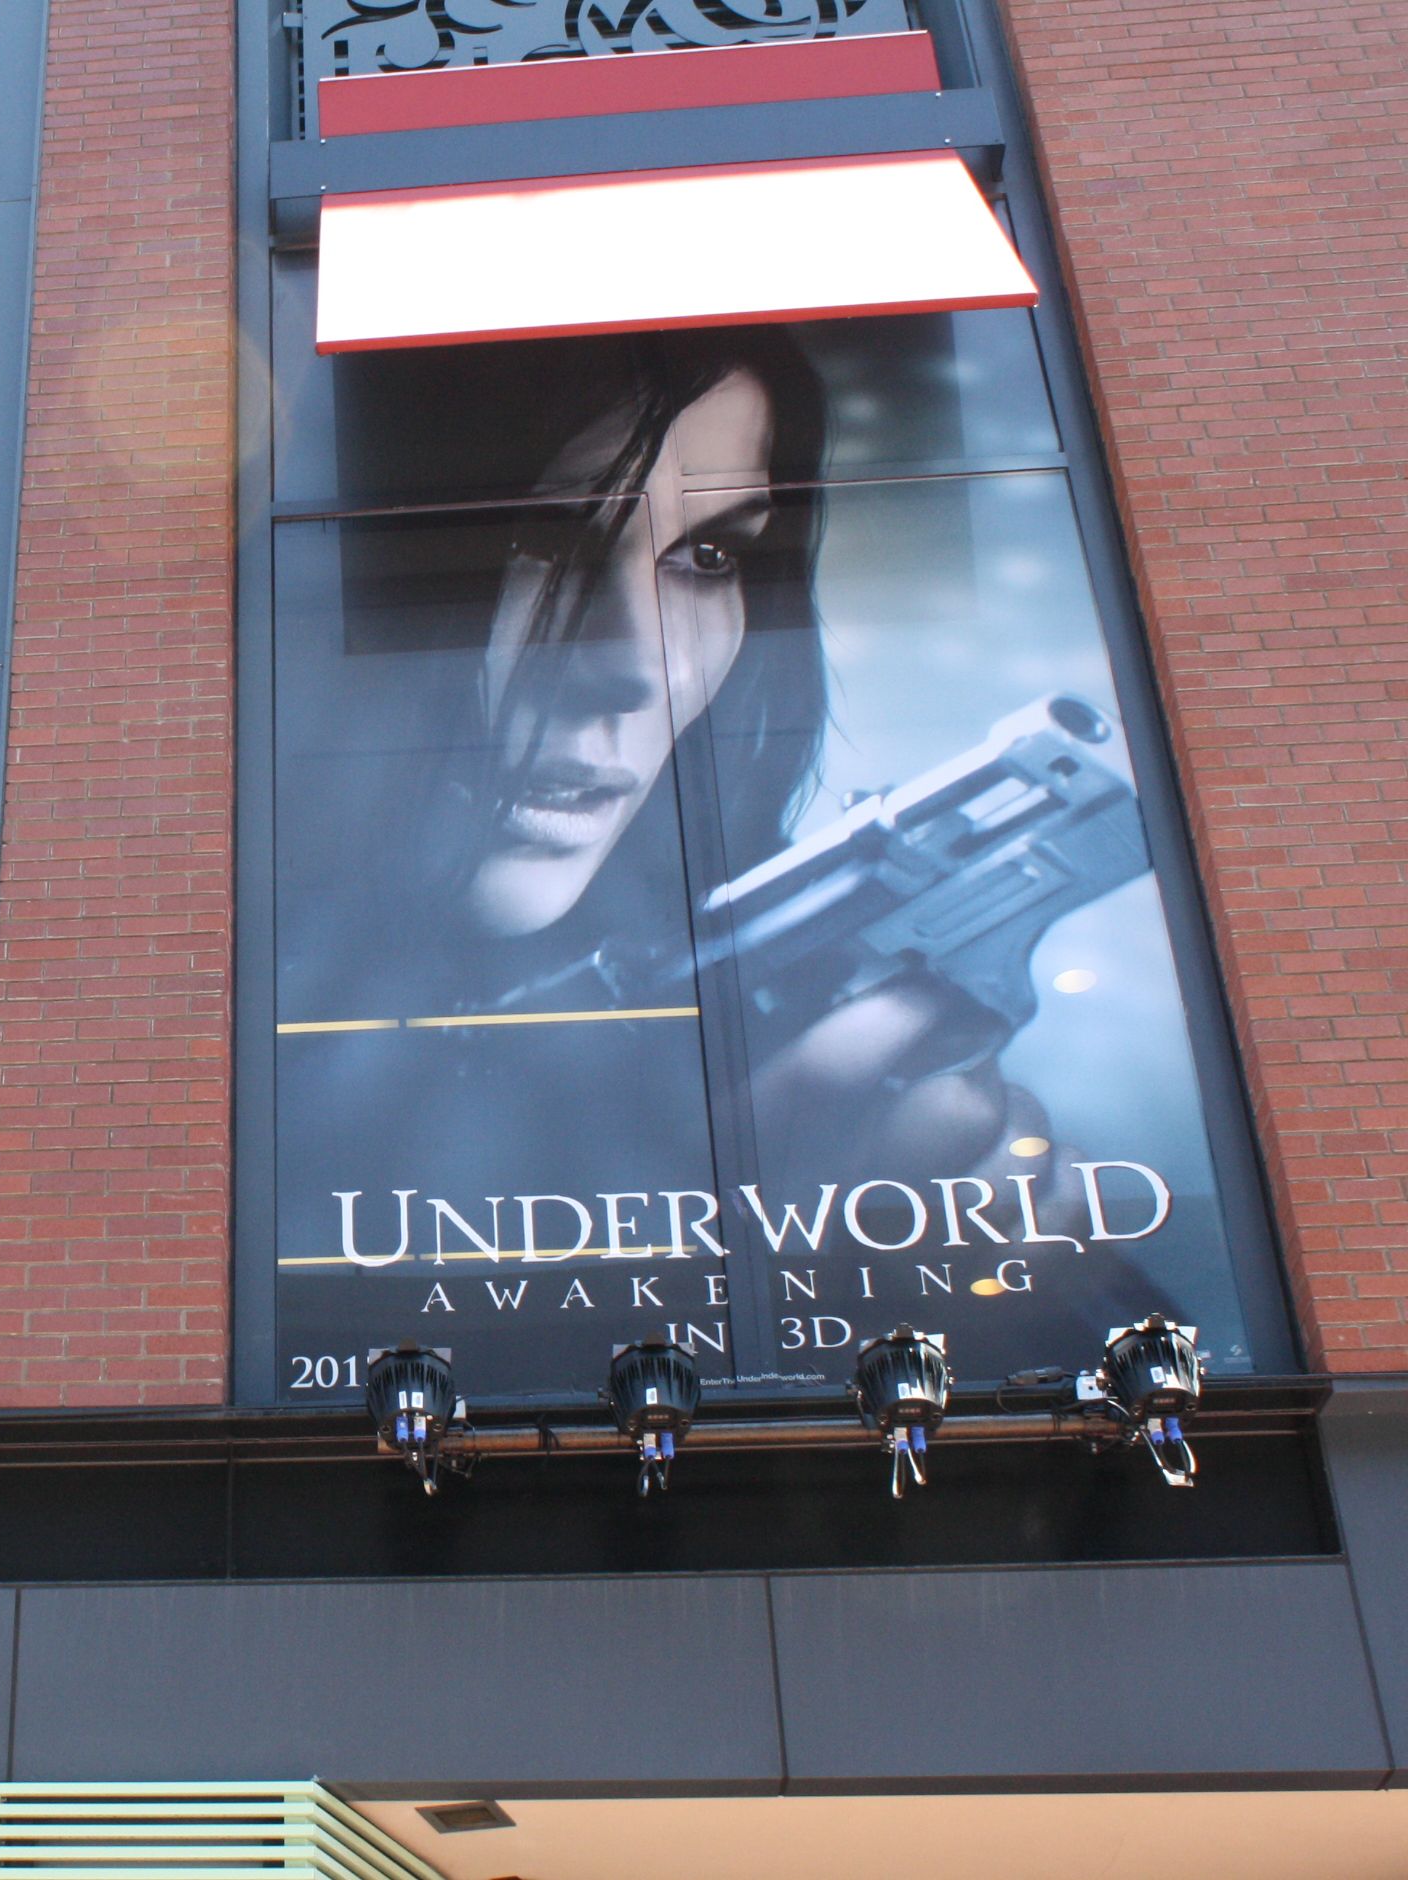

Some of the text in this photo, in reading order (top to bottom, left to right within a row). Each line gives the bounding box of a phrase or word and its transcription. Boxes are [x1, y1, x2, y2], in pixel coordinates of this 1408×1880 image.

[332, 1161, 1173, 1268] UNDERWORLD
[421, 1259, 1033, 1313] AWAKENING
[666, 1315, 853, 1354] IN 3D
[290, 1354, 369, 1388] 201
